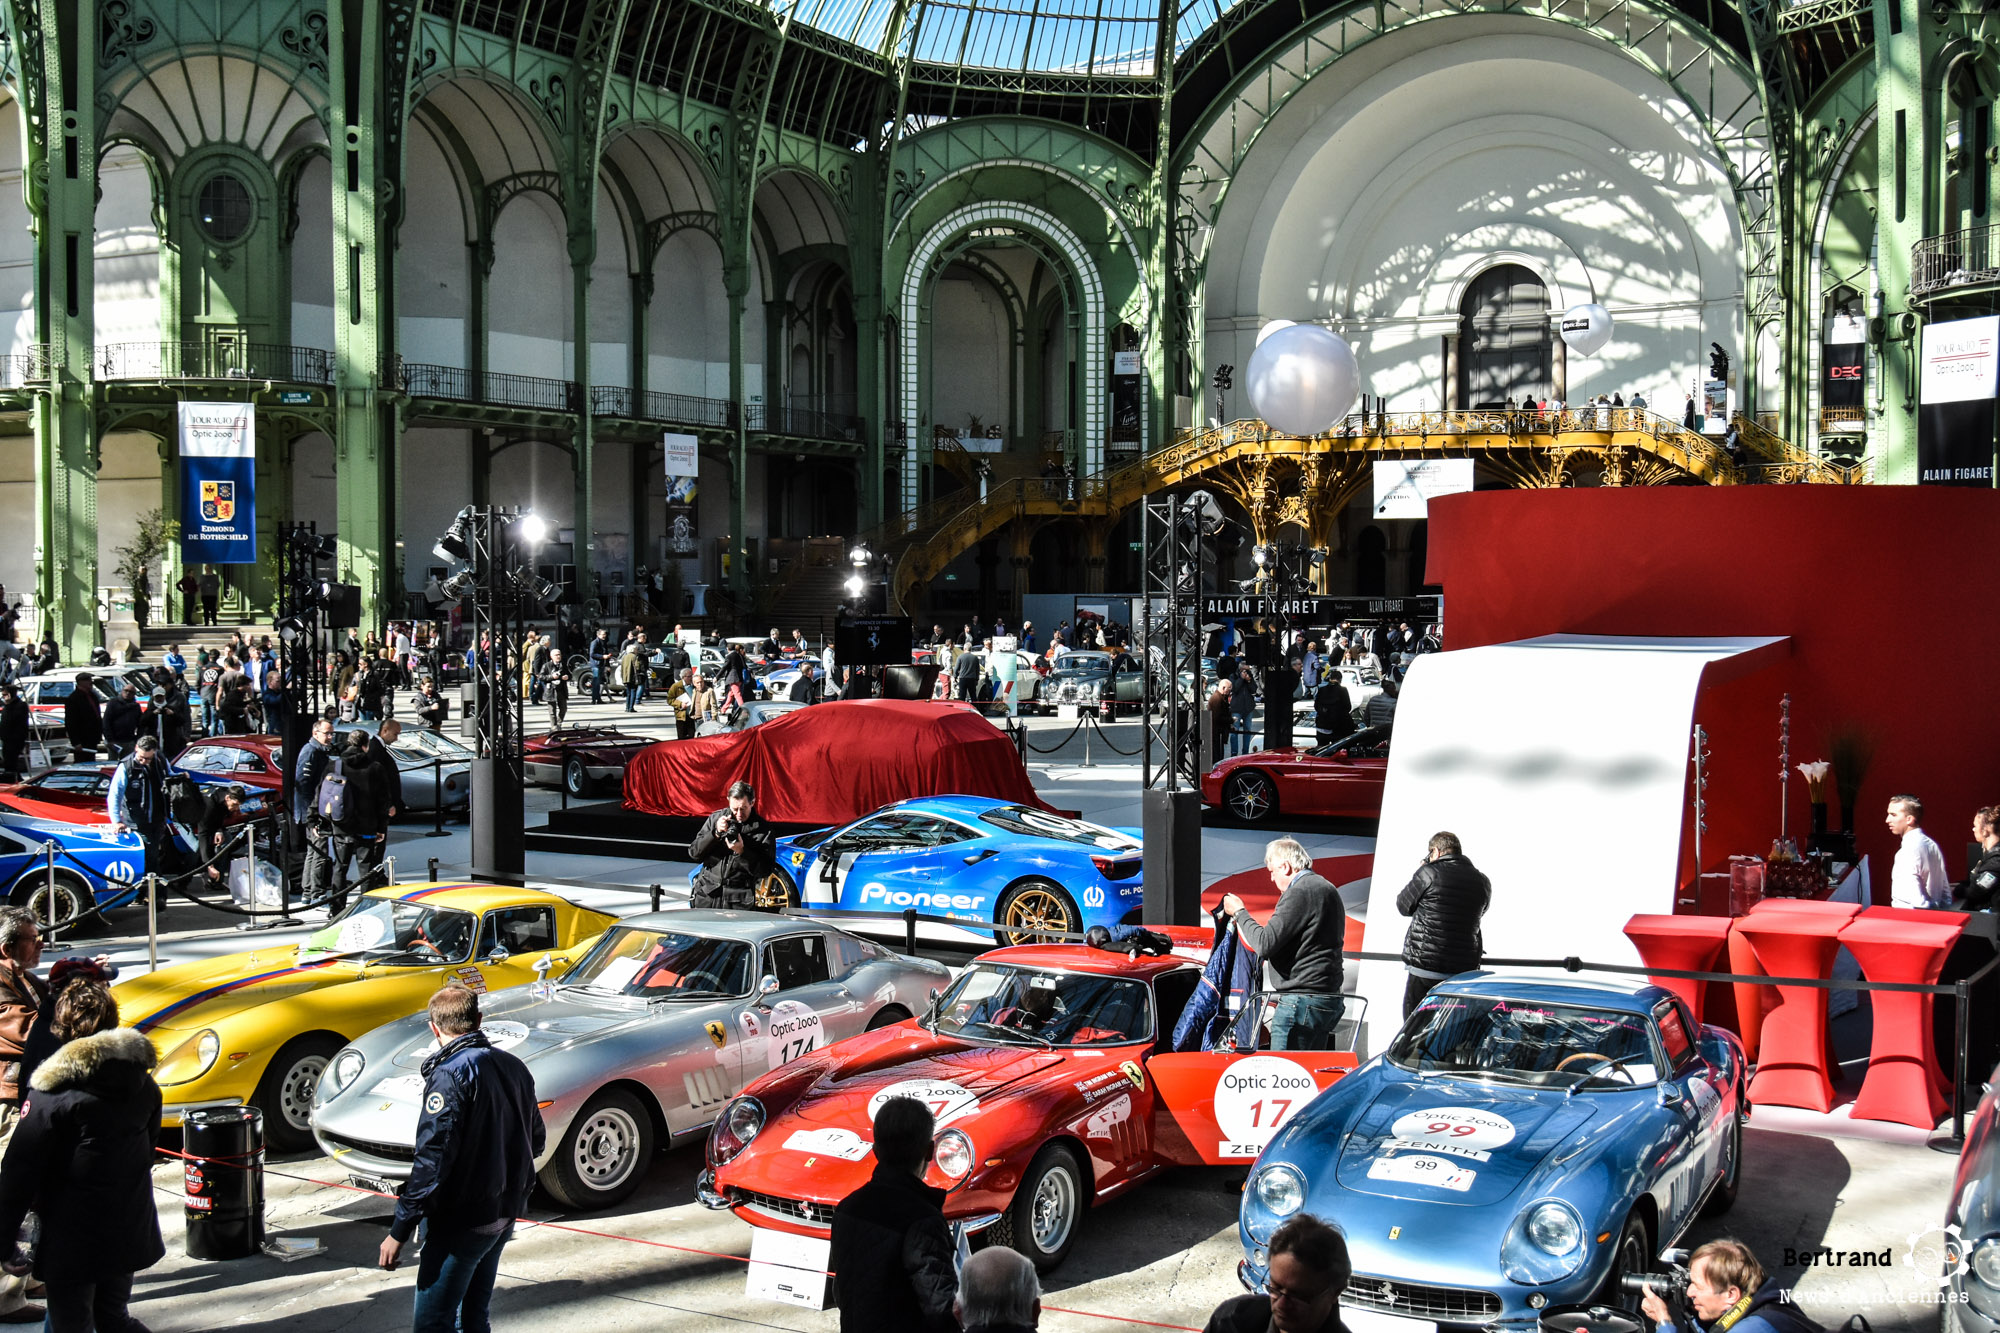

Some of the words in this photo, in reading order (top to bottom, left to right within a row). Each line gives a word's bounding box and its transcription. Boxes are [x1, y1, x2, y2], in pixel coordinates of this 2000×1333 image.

[1831, 365, 1862, 378] DEC
[1936, 364, 1955, 375] Optic
[192, 416, 212, 424] TOUR
[191, 429, 213, 440] Optic
[214, 430, 233, 438] 2000
[1923, 468, 1951, 481] ALAIN
[1955, 466, 1993, 480] FIGARET
[201, 525, 235, 533] EDMOND
[200, 533, 249, 541] ROTHSCHILD
[1207, 599, 1250, 614] ALAIN
[1369, 600, 1384, 613] ALAIN
[1384, 599, 1404, 613] FIGARET
[819, 856, 840, 904] 4
[859, 881, 985, 910] Pioneer
[1120, 888, 1132, 896] CH.
[457, 966, 478, 974] MOTUL
[464, 976, 484, 984] MOTUL
[494, 1028, 525, 1039] 2000
[771, 1020, 796, 1039] Optic
[797, 1015, 818, 1030] 2000
[781, 1035, 815, 1064] 174
[1092, 1087, 1108, 1098] SARAH
[1106, 1081, 1122, 1091] INGRAM
[1224, 1074, 1267, 1093] Optic
[1272, 1074, 1311, 1089] 2000
[925, 1088, 967, 1097] 2000
[929, 1100, 950, 1118] 7
[1250, 1099, 1292, 1128] 17
[1413, 1112, 1460, 1120] Optic
[1465, 1116, 1510, 1130] 2000
[1423, 1122, 1477, 1137] 99
[826, 1133, 843, 1142] 17
[1394, 1140, 1479, 1157] ZENITH
[1414, 1160, 1438, 1171] 99
[1721, 1308, 1740, 1327] Nikon
